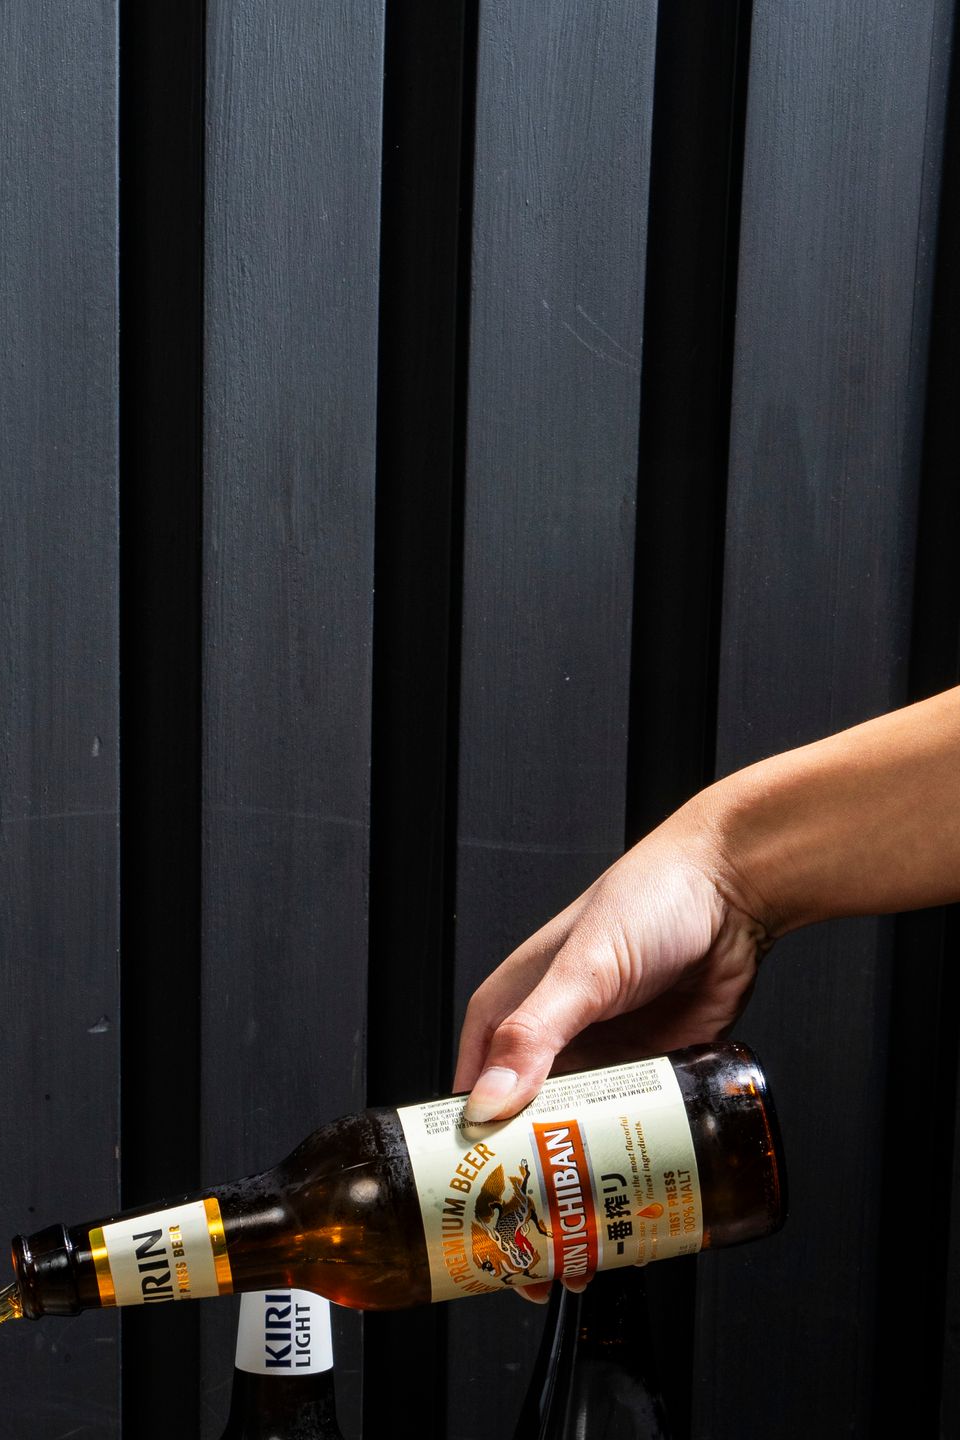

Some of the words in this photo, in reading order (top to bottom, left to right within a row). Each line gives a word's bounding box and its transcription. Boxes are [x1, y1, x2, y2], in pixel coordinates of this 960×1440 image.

[619, 1085, 663, 1098] GOVERNMENT
[449, 1143, 495, 1194] BEER
[629, 1153, 640, 1173] most
[544, 1128, 586, 1241] ICHIBAN
[632, 1175, 640, 1188] the
[644, 1174, 654, 1200] finest
[664, 1171, 679, 1208] PRESS
[678, 1169, 694, 1203] MALT
[601, 1173, 633, 1255] 一番搾り
[669, 1212, 681, 1237] FIRST
[684, 1205, 696, 1234] 100%
[169, 1224, 185, 1258] BEER
[442, 1198, 475, 1284] PREMIUM
[132, 1229, 174, 1304] IRIN
[563, 1243, 588, 1278] IRIN
[264, 1294, 292, 1369] KIRI
[295, 1303, 311, 1368] LIGHT
